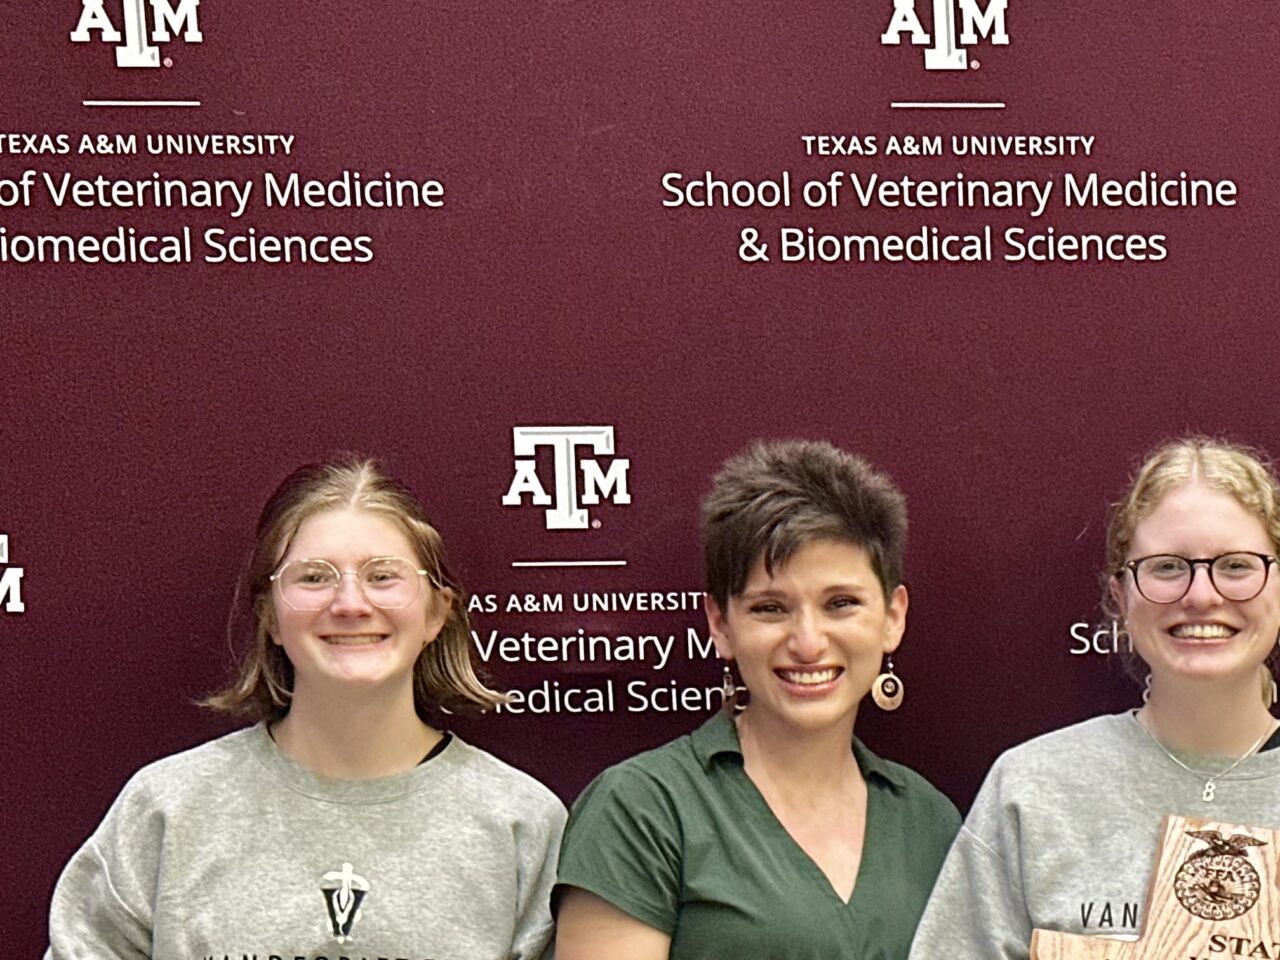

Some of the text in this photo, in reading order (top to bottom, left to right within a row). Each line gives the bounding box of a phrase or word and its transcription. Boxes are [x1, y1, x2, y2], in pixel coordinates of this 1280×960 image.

[0, 134, 295, 155] TEXAS A&M UNIVERSITY
[801, 135, 1095, 156] TEXAS A&M UNIVERSITY
[0, 169, 444, 218] of Veterinary Medicine
[662, 170, 1237, 217] School of Veterinary Medicine
[204, 227, 374, 263] Sciences
[738, 225, 1167, 262] & Biomedical Sciences
[506, 593, 564, 613] A&M
[573, 591, 708, 612] UNIVERSIT
[471, 628, 675, 671] Veterinary
[495, 680, 615, 714] edical
